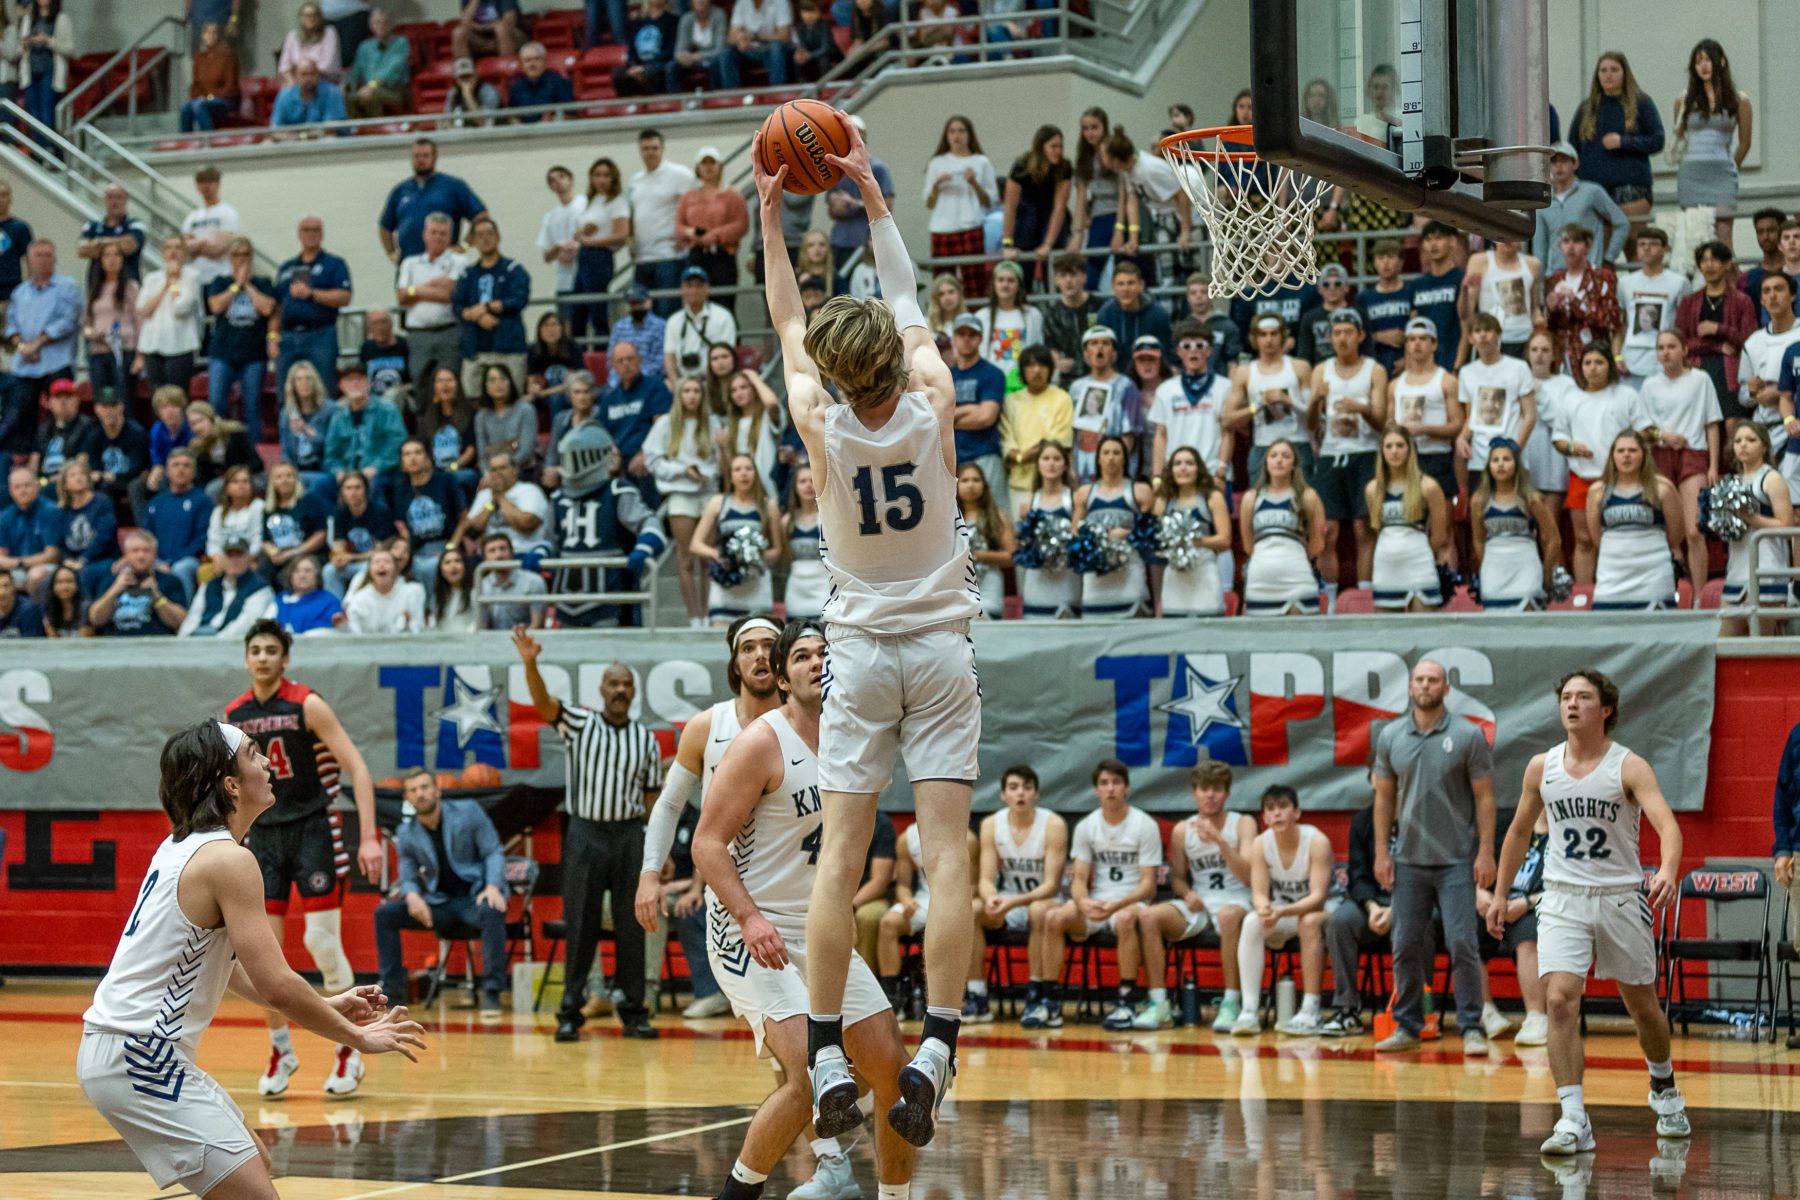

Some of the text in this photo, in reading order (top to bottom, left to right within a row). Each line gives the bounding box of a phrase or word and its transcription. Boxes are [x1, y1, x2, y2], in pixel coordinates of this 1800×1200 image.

[795, 121, 833, 182] Wilson
[852, 461, 926, 536] 15
[558, 498, 601, 549] H
[265, 736, 294, 779] 4
[1563, 827, 1612, 860] 22
[1691, 871, 1760, 892] WEST
